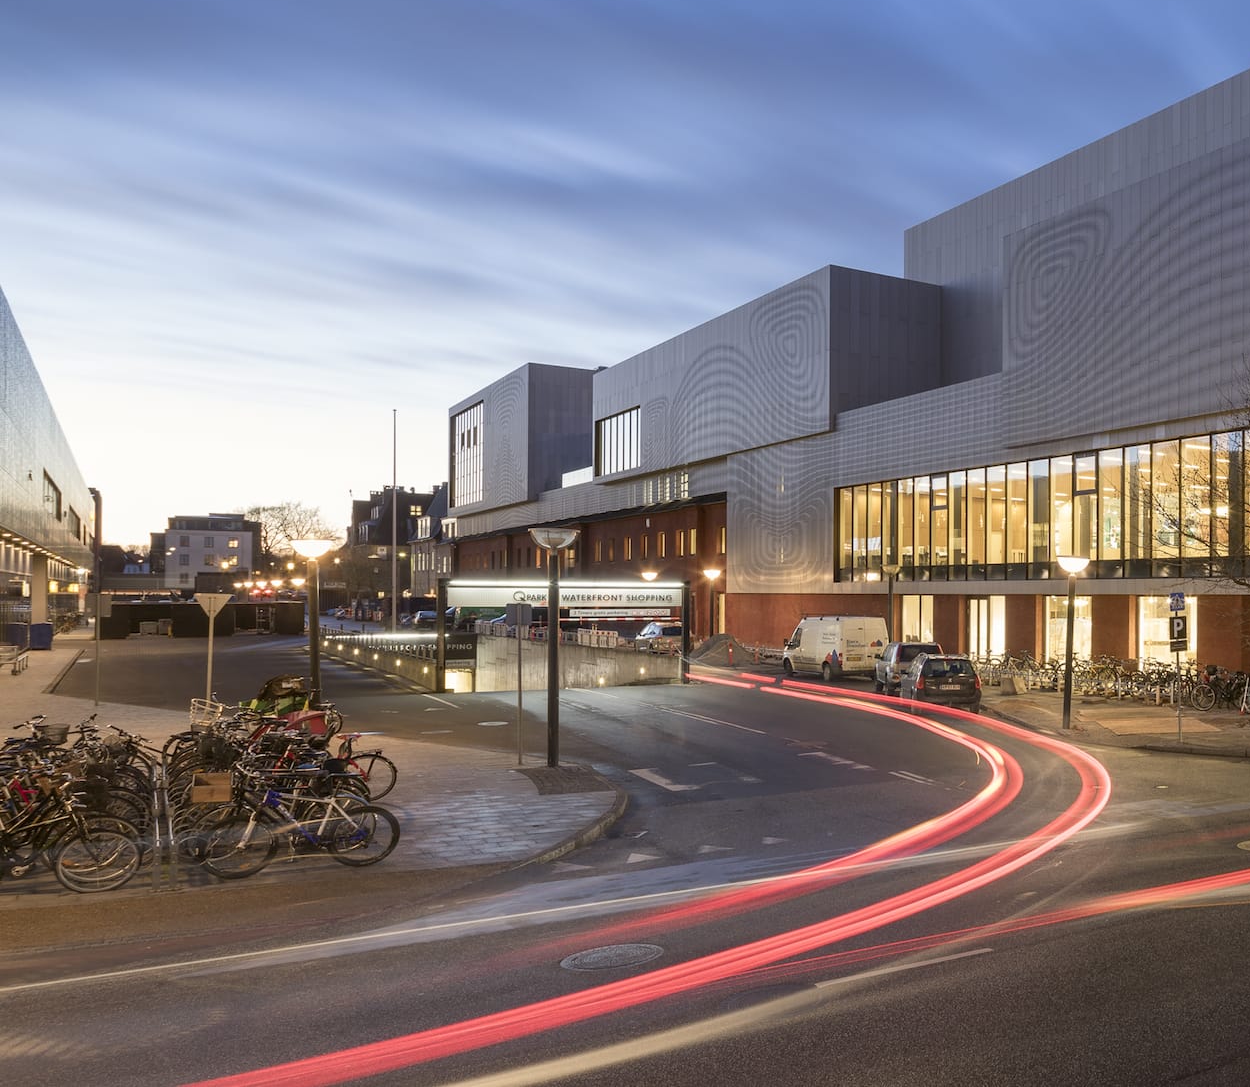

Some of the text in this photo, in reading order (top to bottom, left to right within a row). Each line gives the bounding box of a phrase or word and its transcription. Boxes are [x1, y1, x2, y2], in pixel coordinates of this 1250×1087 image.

[561, 594, 623, 602] WATERFRONT
[626, 594, 673, 603] SHOPPING
[1173, 619, 1184, 638] P
